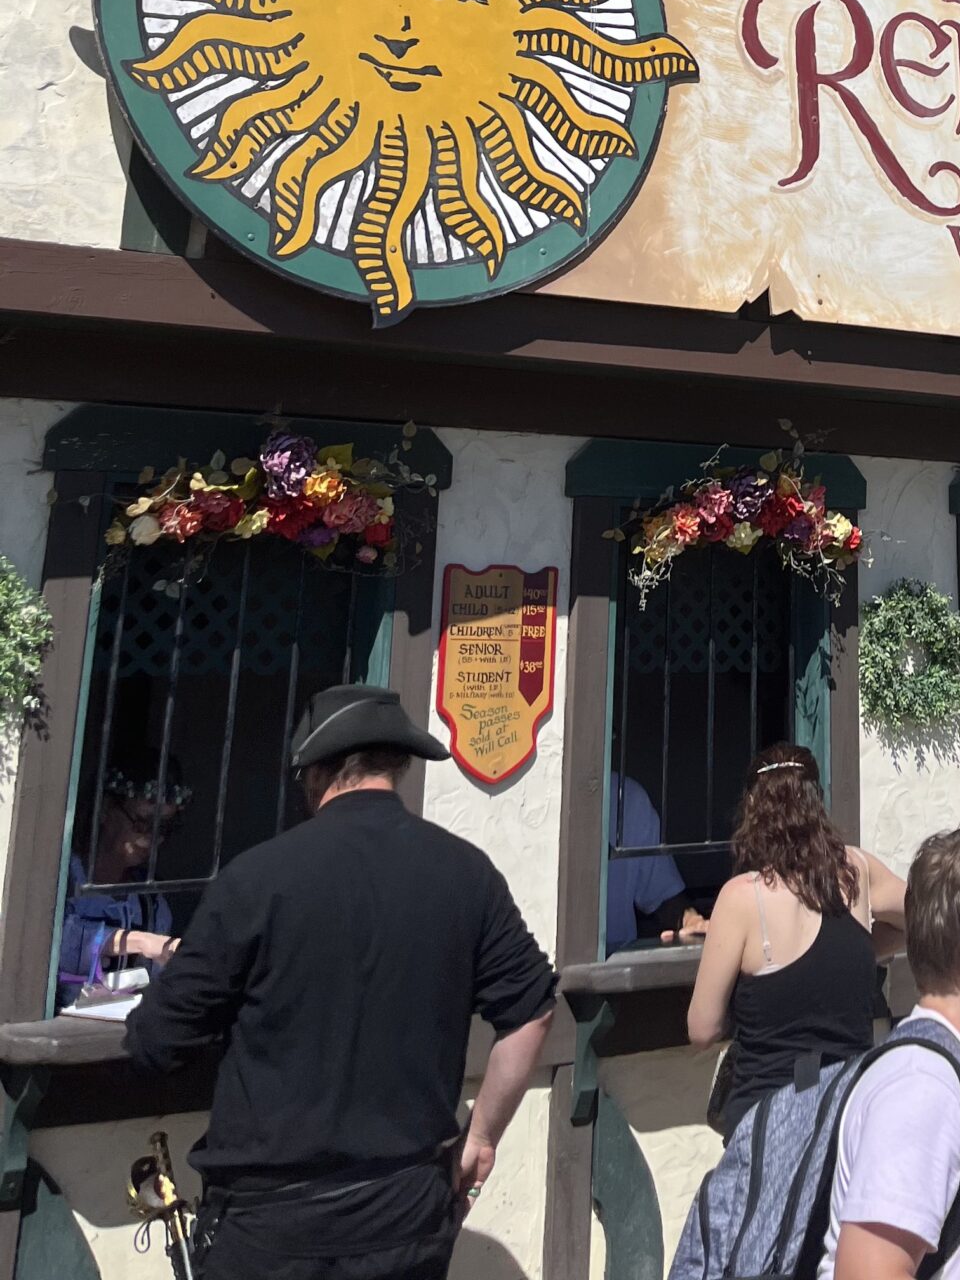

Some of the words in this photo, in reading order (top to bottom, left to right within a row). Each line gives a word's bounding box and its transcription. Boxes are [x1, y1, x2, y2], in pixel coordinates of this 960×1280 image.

[464, 584, 512, 599] ADULT
[452, 603, 488, 616] CHILD
[450, 624, 503, 639] CHILDREN
[522, 625, 545, 639] FREE
[459, 643, 503, 655] SENIOR
[456, 671, 512, 684] STUDENT
[460, 703, 508, 720] Season
[479, 711, 521, 735] passes
[474, 740, 495, 757] Will
[497, 730, 518, 748] Call
